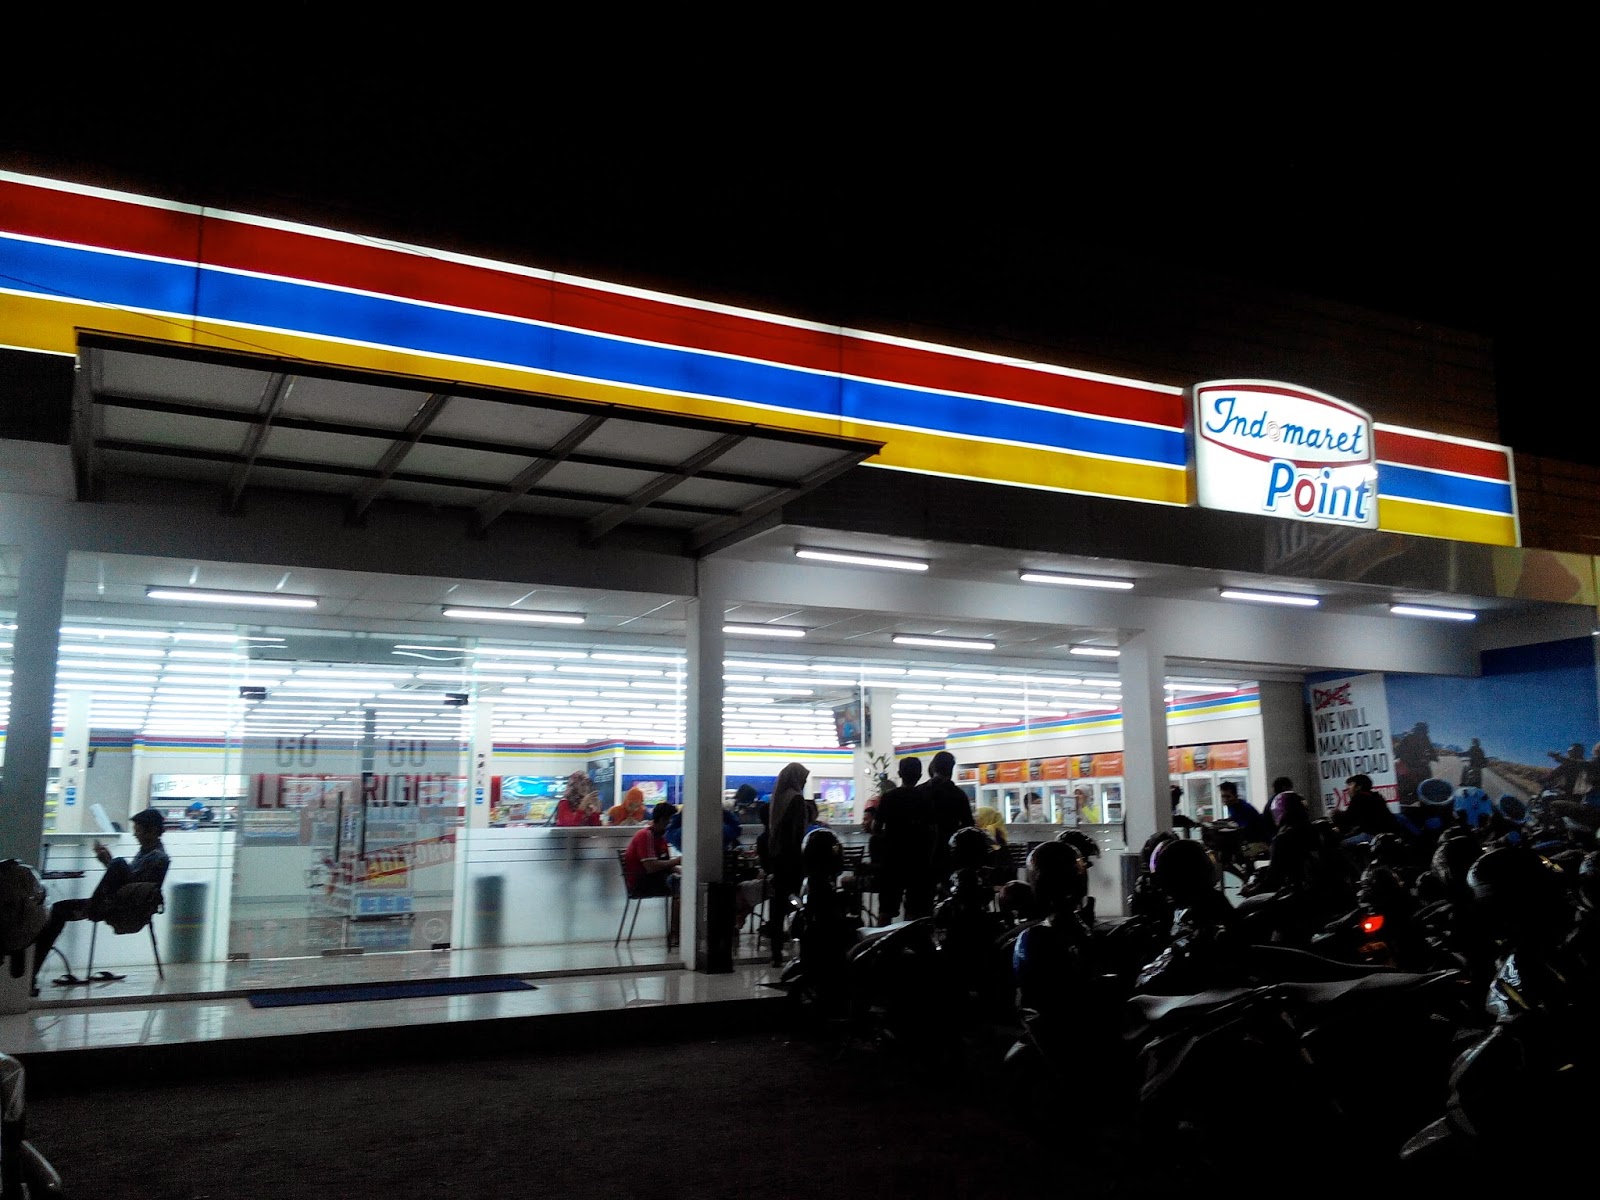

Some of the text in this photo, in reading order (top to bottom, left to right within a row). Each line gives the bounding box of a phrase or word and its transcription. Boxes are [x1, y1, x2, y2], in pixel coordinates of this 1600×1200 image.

[1206, 397, 1363, 454] Indomaret
[1266, 462, 1370, 520] Point
[1315, 707, 1370, 733] WE WILL
[1318, 729, 1385, 758] MAKE OUR
[1321, 752, 1390, 780] OWN ROAD
[256, 773, 332, 808] LEFT
